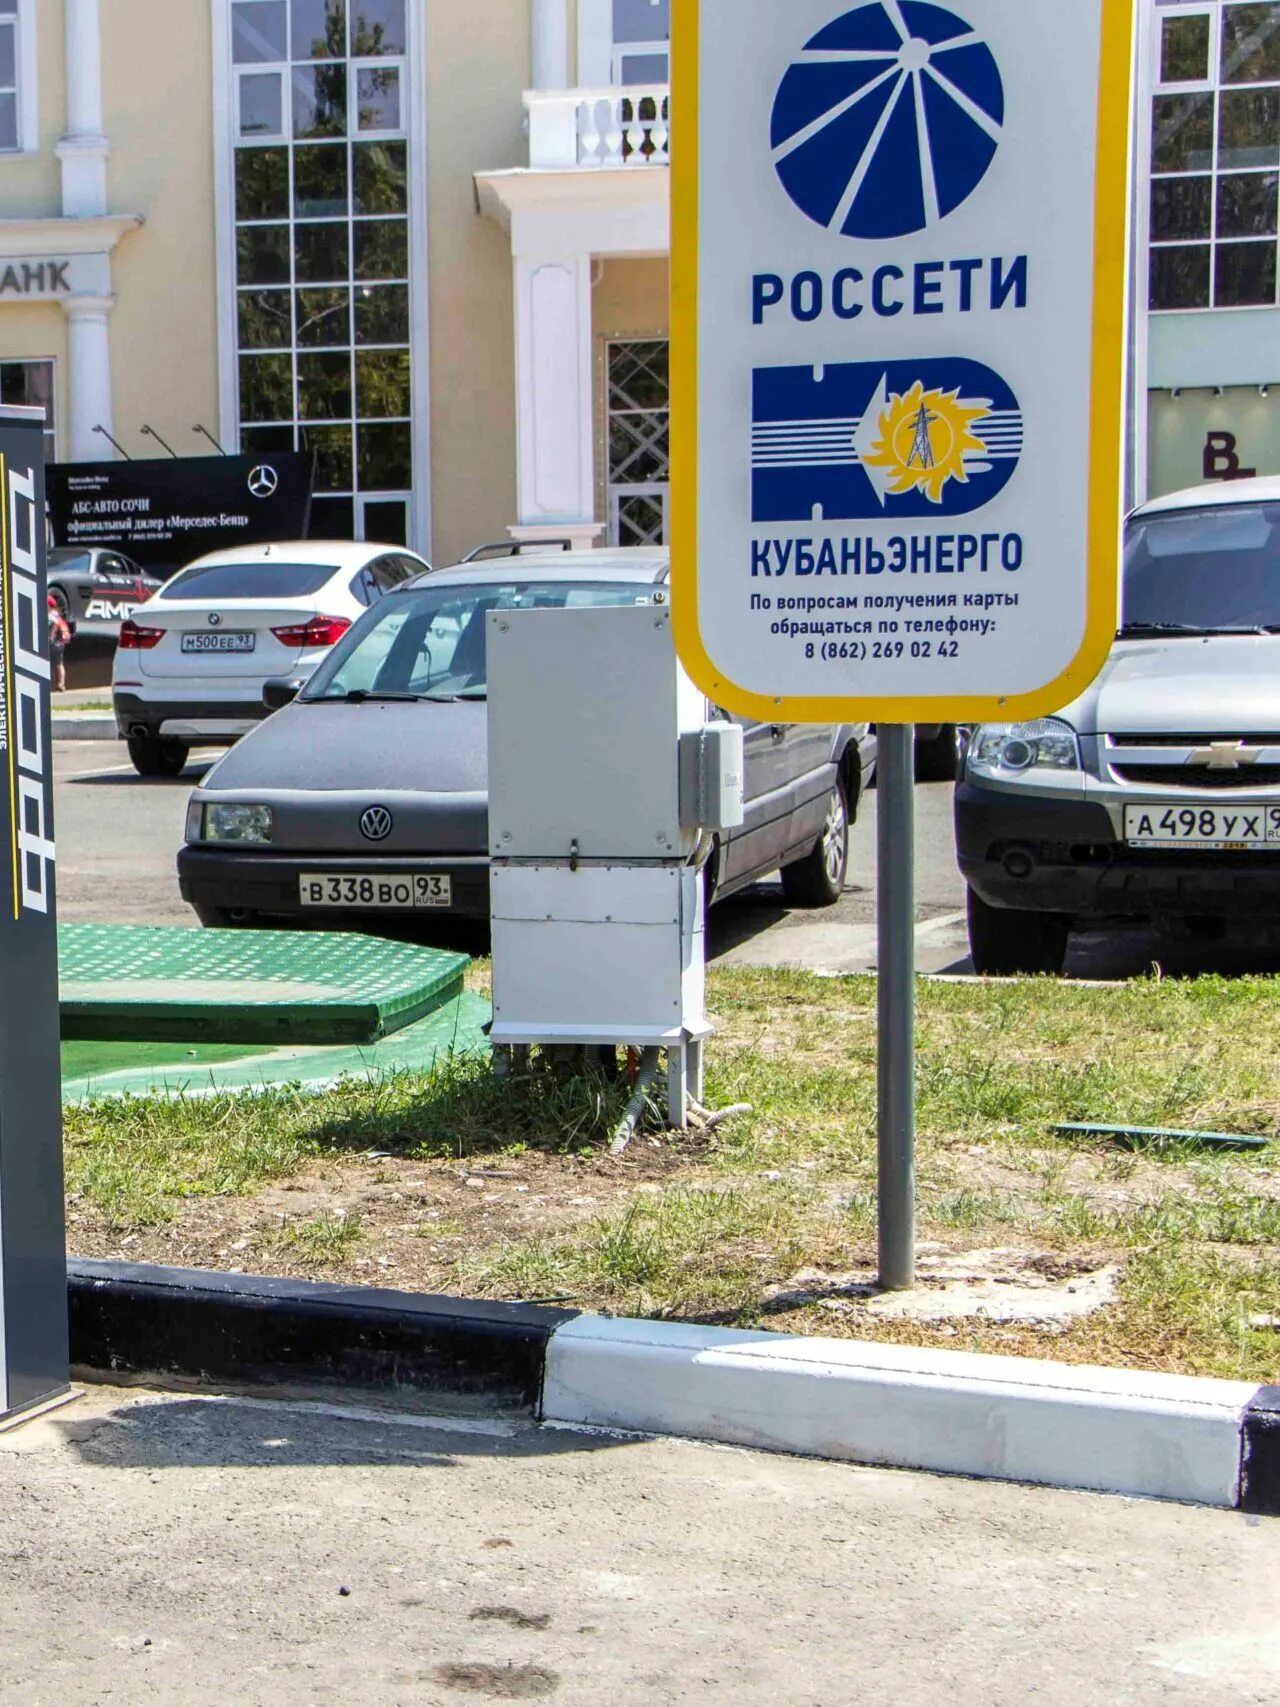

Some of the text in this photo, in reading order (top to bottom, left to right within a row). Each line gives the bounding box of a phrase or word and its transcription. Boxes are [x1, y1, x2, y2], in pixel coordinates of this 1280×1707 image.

[751, 255, 1028, 325] РОССЕТИ
[71, 498, 150, 515] АБС-АВТО СОЧИ
[67, 517, 132, 536] официальный
[134, 517, 164, 532] дилер
[751, 533, 1023, 577] КУБАНЬЭНЕРГО
[750, 592, 1019, 613] По вопросам получения карты
[770, 616, 996, 638] обращаться по телефону:
[805, 640, 959, 661] 8 (862) 269 02 42
[416, 877, 442, 896] 93
[416, 896, 434, 904] RUS
